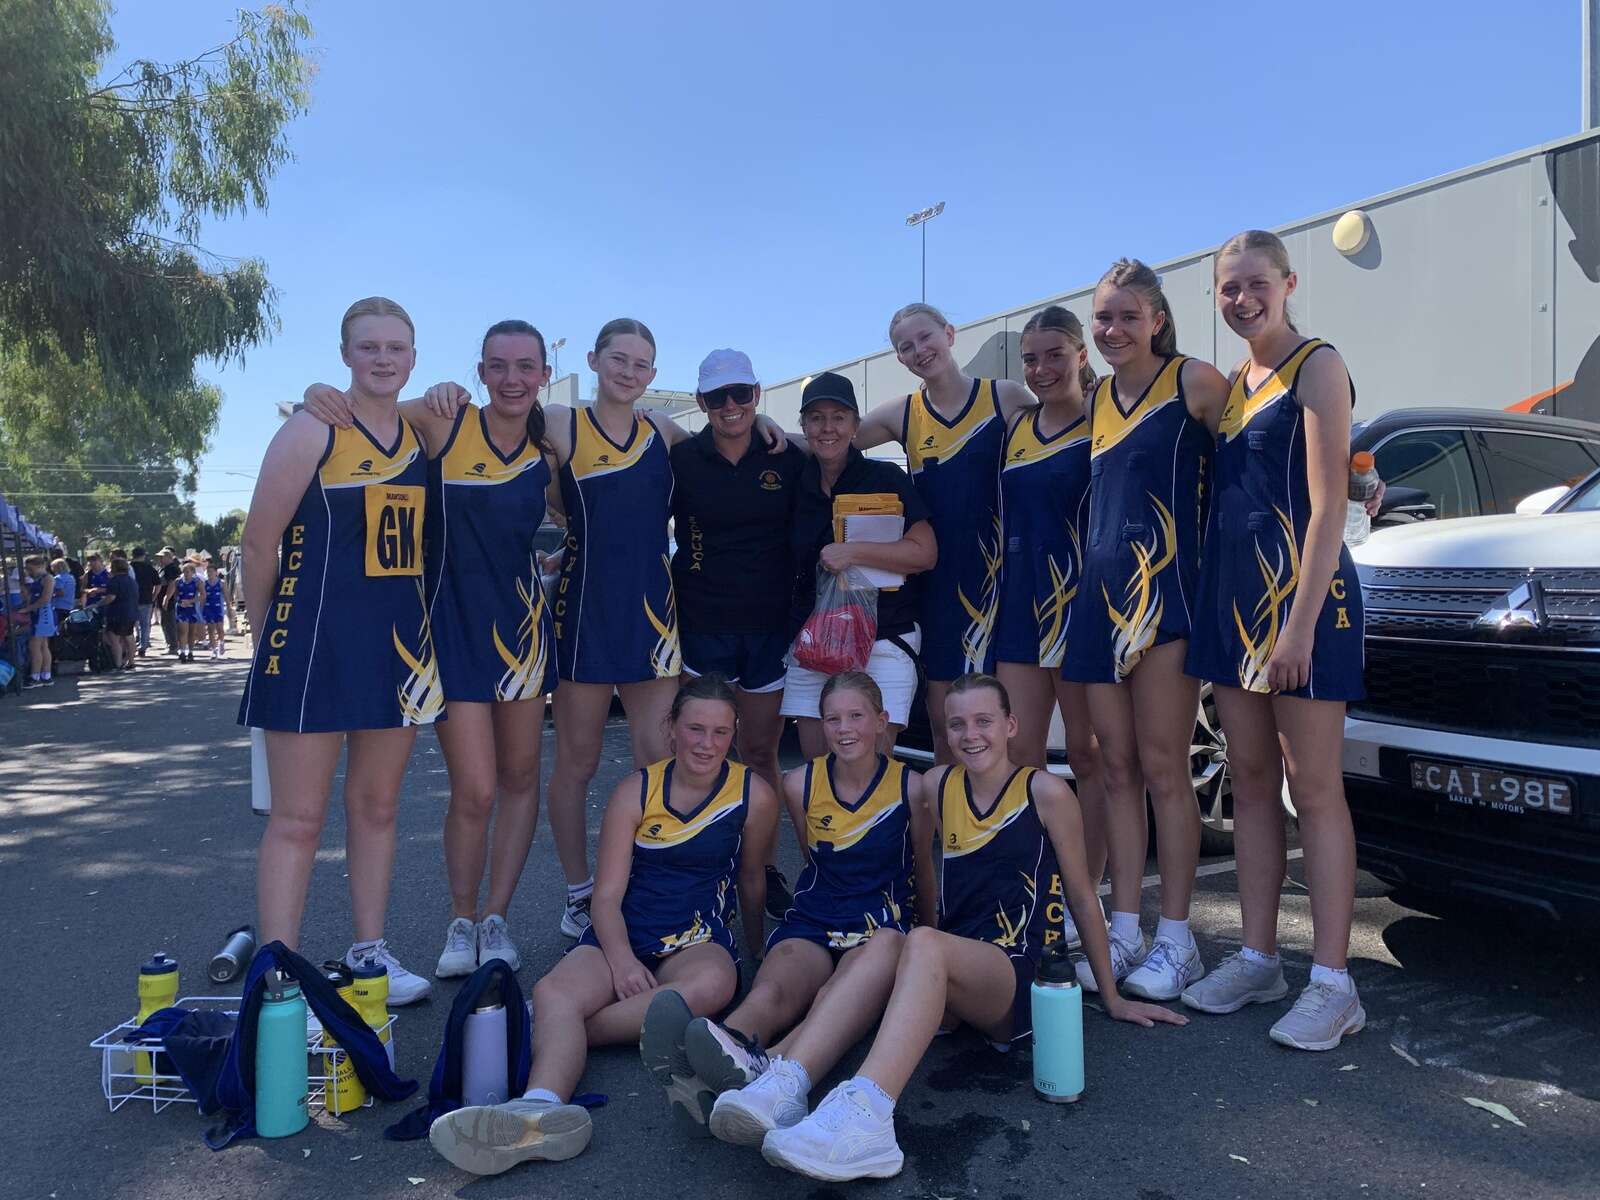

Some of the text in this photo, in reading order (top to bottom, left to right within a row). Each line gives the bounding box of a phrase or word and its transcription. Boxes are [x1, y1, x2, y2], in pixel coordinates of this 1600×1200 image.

[377, 505, 416, 569] GK
[265, 525, 305, 675] ECHUCA
[1491, 801, 1525, 815] MOTORS
